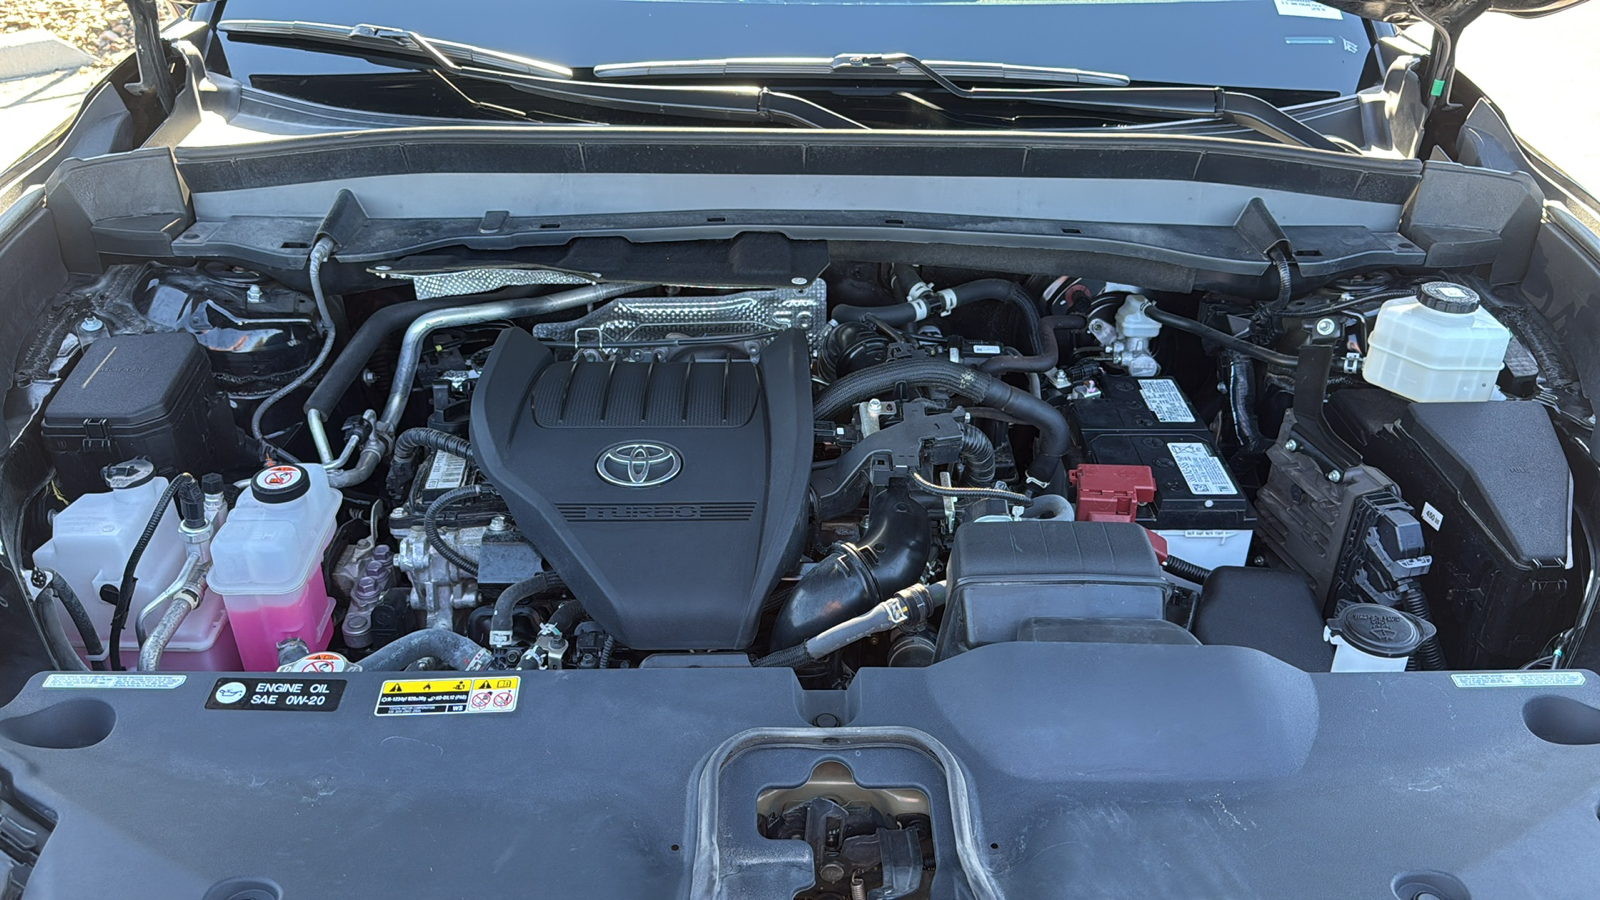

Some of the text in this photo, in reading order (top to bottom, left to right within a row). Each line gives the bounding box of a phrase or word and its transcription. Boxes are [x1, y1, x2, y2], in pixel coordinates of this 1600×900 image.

[588, 506, 698, 518] TURBO
[256, 683, 330, 694] ENGINE OIL
[250, 695, 325, 705] SAE 0W-20
